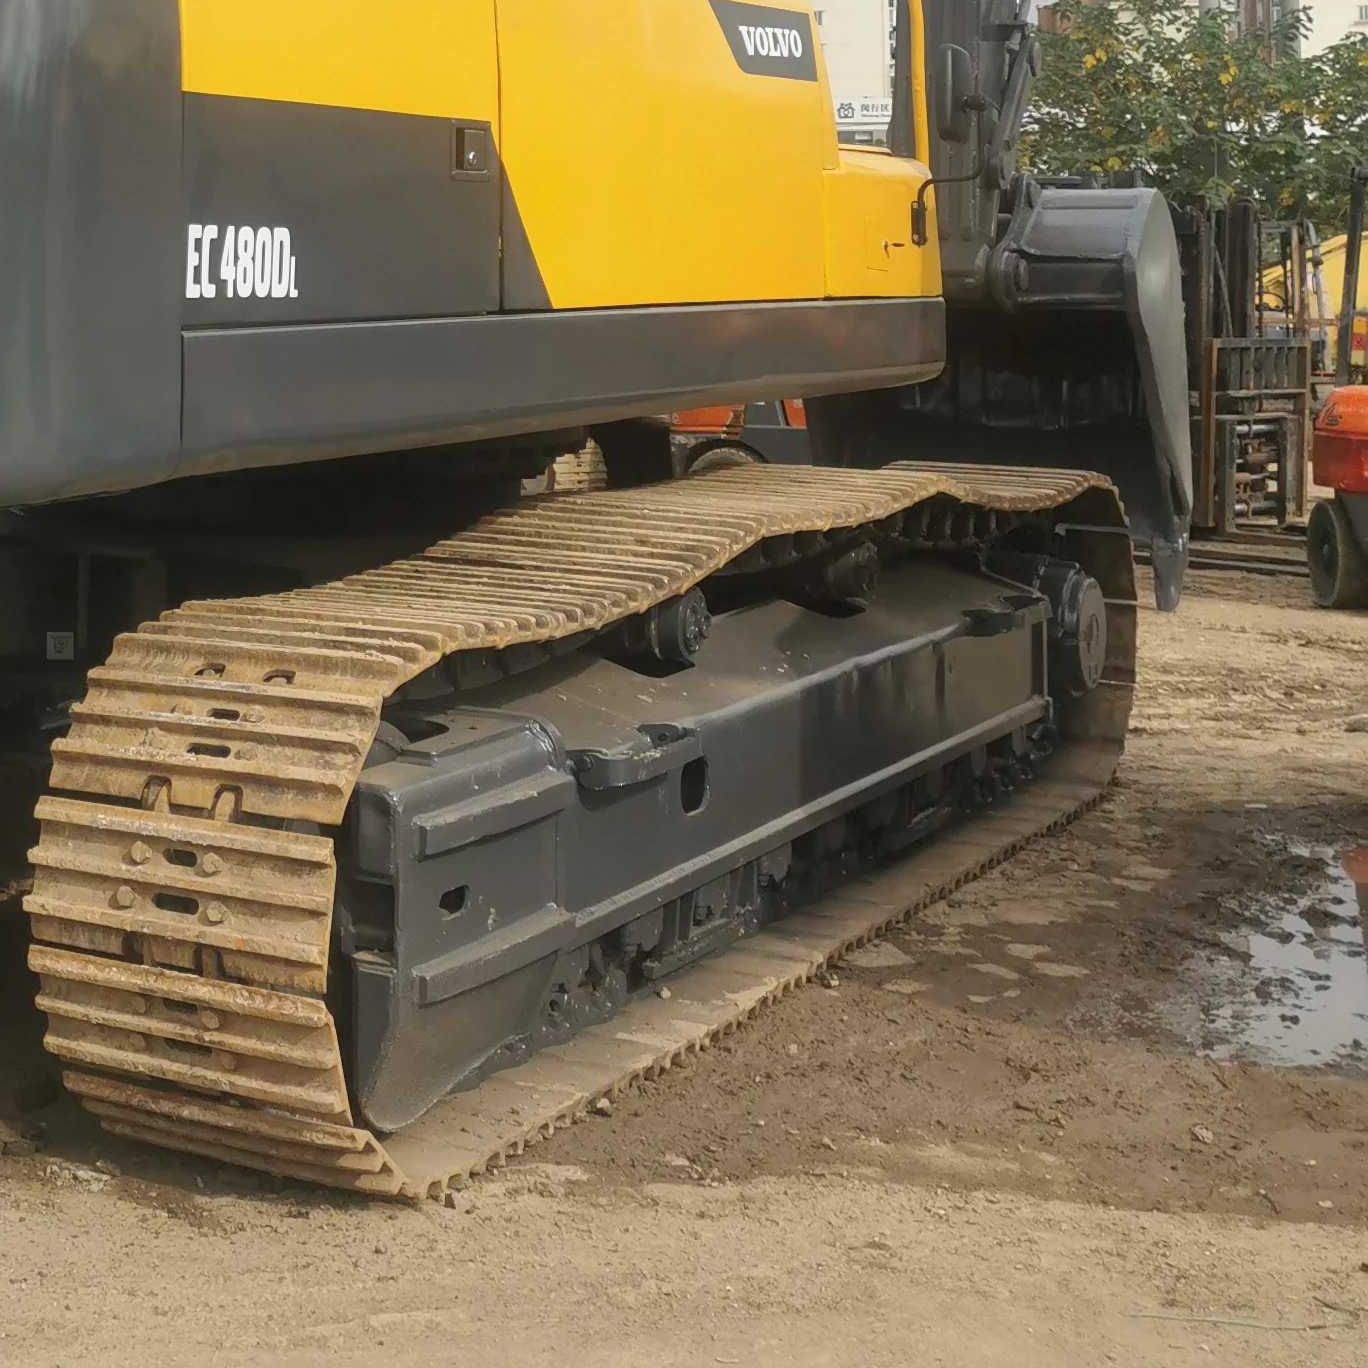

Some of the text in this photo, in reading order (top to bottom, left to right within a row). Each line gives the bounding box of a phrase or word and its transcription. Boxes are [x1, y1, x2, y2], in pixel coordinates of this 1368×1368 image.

[737, 25, 803, 58] VOLVO
[860, 103, 892, 112] 闵行区
[185, 223, 219, 299] EC
